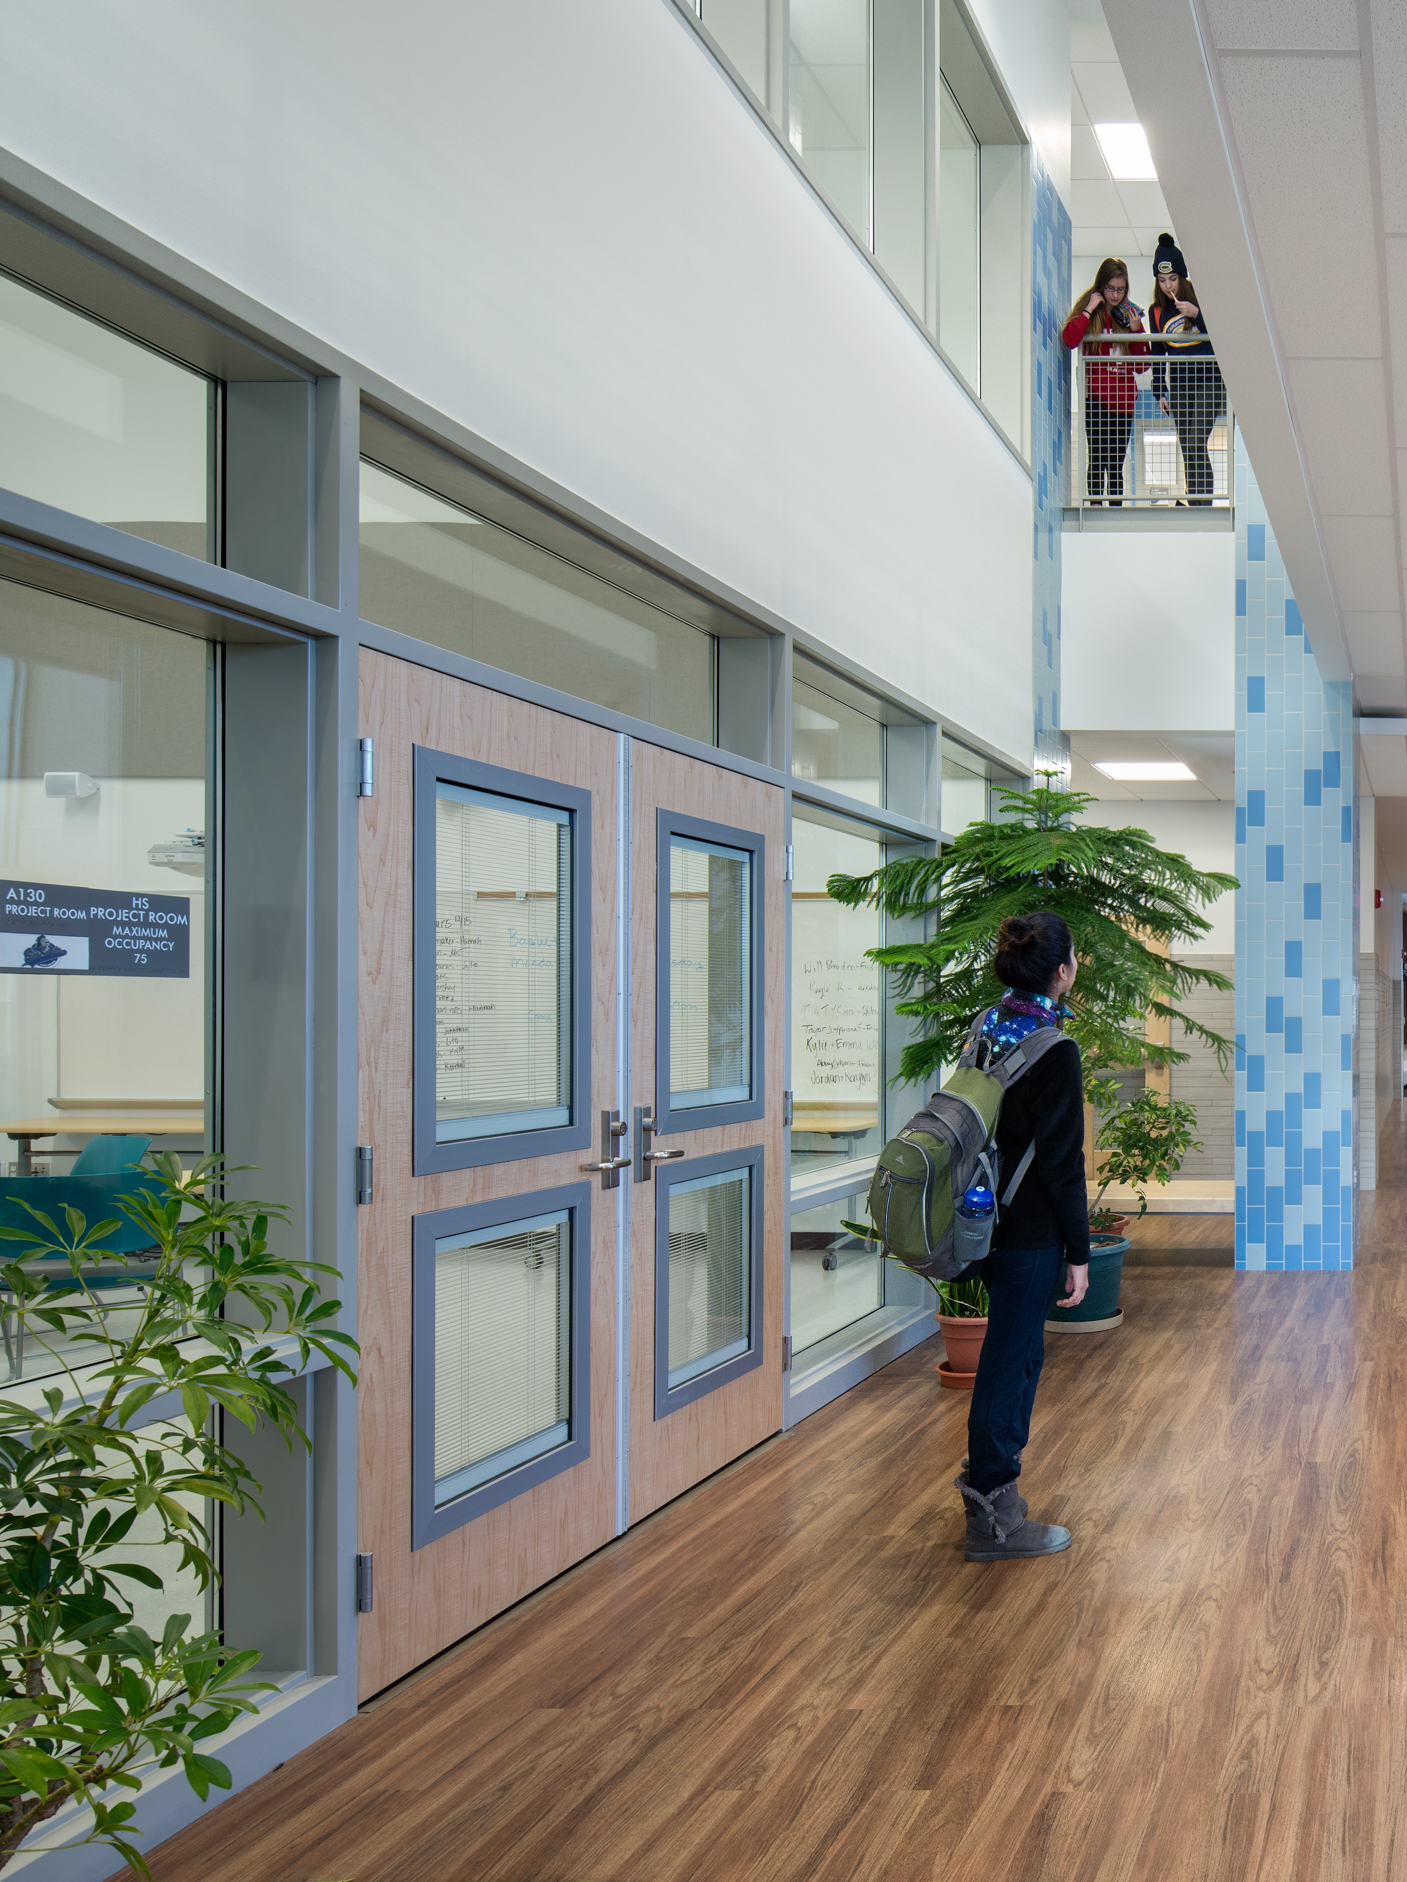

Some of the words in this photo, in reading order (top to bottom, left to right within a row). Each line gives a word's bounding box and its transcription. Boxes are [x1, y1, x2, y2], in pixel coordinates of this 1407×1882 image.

[6, 888, 45, 902] A130
[132, 897, 149, 909] HS
[6, 904, 51, 917] PROJECT
[53, 907, 87, 920] ROOM
[90, 907, 145, 922] PROJECT
[149, 912, 188, 925] ROOM
[112, 925, 168, 938] MAXIMUM
[105, 938, 175, 951] OCCUPANCY
[134, 954, 148, 964] 75
[804, 960, 823, 974] Will
